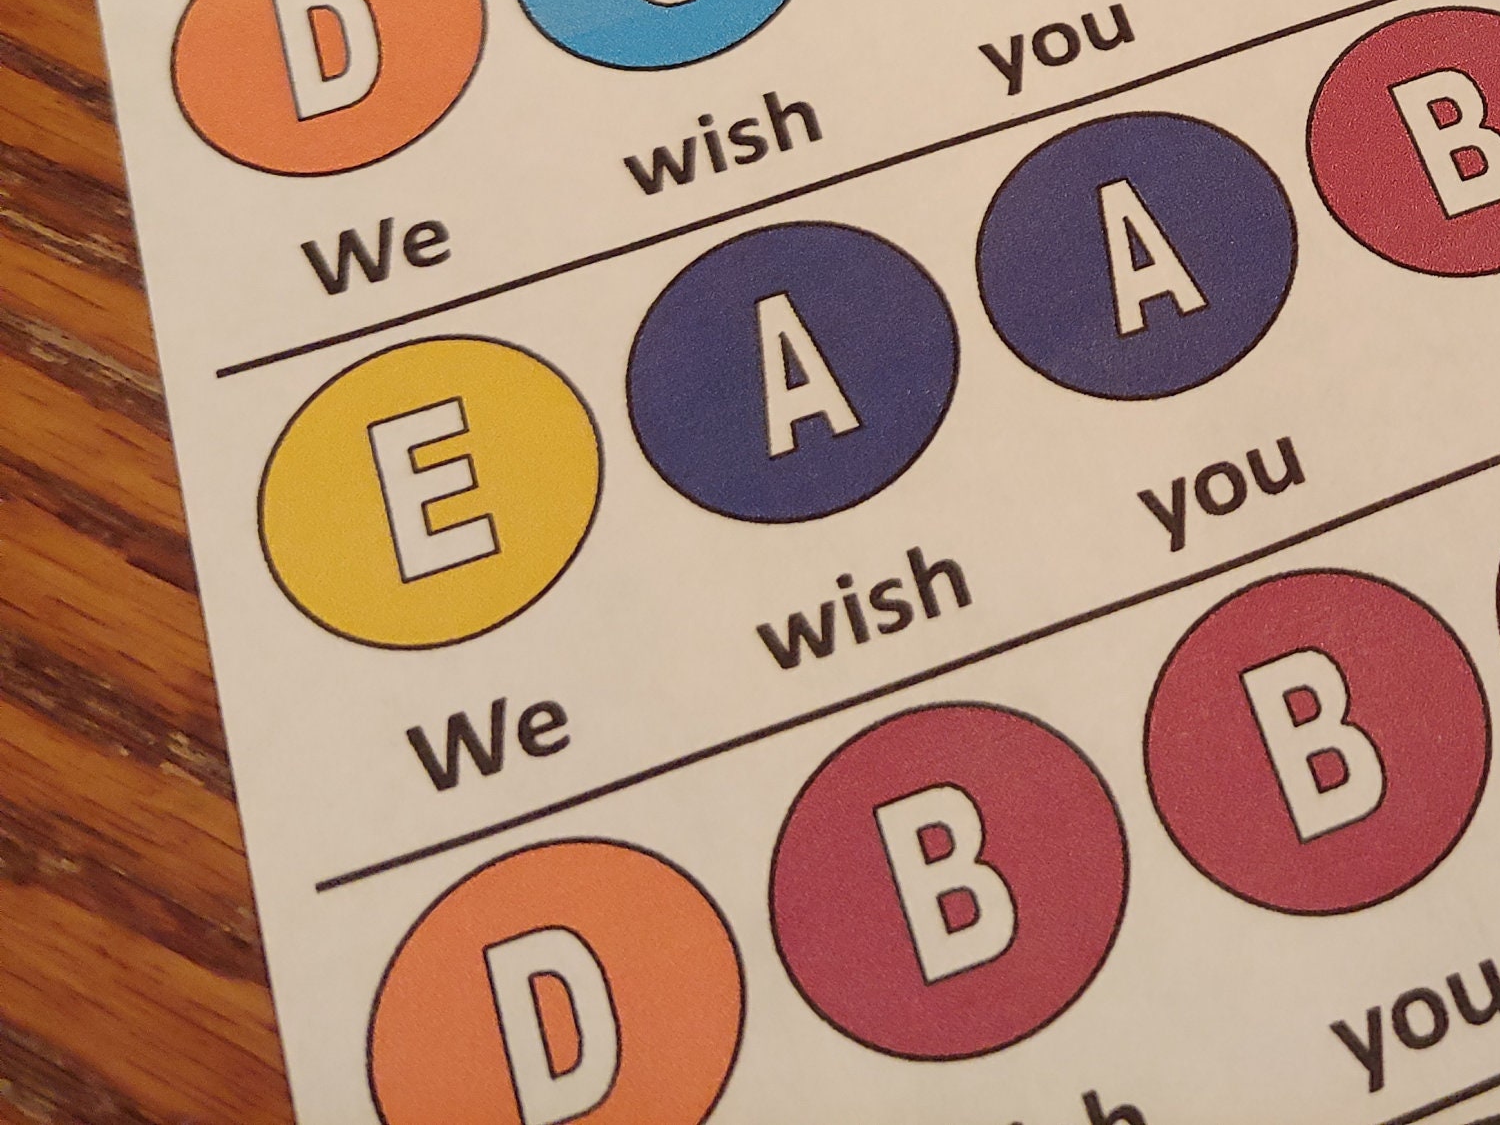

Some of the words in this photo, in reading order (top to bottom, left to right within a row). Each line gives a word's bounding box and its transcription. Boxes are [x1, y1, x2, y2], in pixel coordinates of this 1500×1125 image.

[301, 218, 451, 296] We
[623, 91, 823, 196] wish
[979, 3, 1136, 95] you
[367, 396, 501, 584] E
[754, 290, 862, 461] A
[1097, 176, 1209, 339] A
[405, 696, 572, 791] We
[755, 546, 973, 670] wish
[1137, 436, 1306, 552] you
[482, 924, 622, 1125] D
[873, 781, 1020, 986] B
[1238, 646, 1389, 846] B
